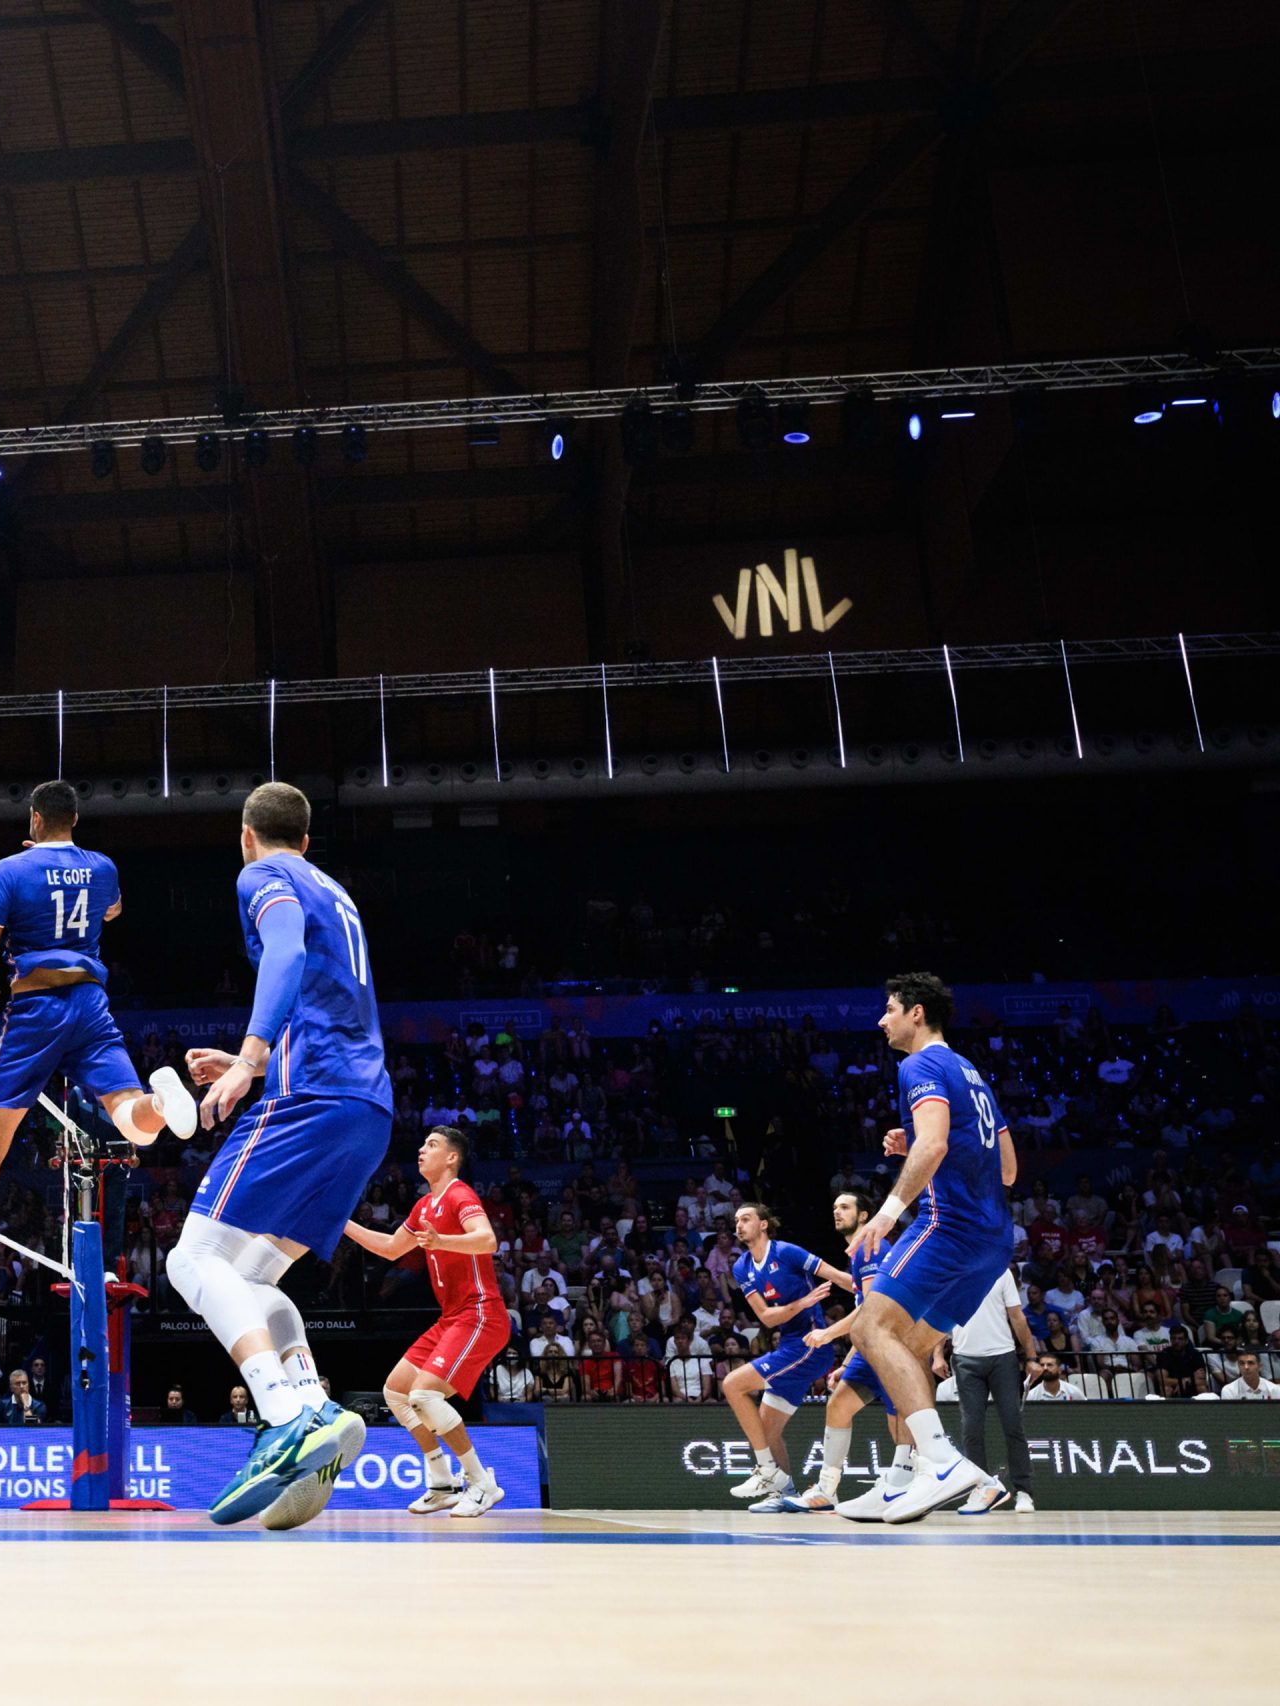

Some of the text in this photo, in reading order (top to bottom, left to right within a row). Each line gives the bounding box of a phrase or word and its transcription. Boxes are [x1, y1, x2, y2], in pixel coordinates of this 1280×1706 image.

[712, 548, 853, 641] VNL
[46, 868, 93, 886] LE GOFF
[50, 888, 90, 940] 14
[334, 901, 368, 987] 17
[969, 1088, 996, 1149] 19
[160, 1321, 210, 1331] PALCO LUC
[326, 1320, 357, 1330] DALLA
[683, 1440, 755, 1476] GE
[1026, 1440, 1212, 1475] FINALS
